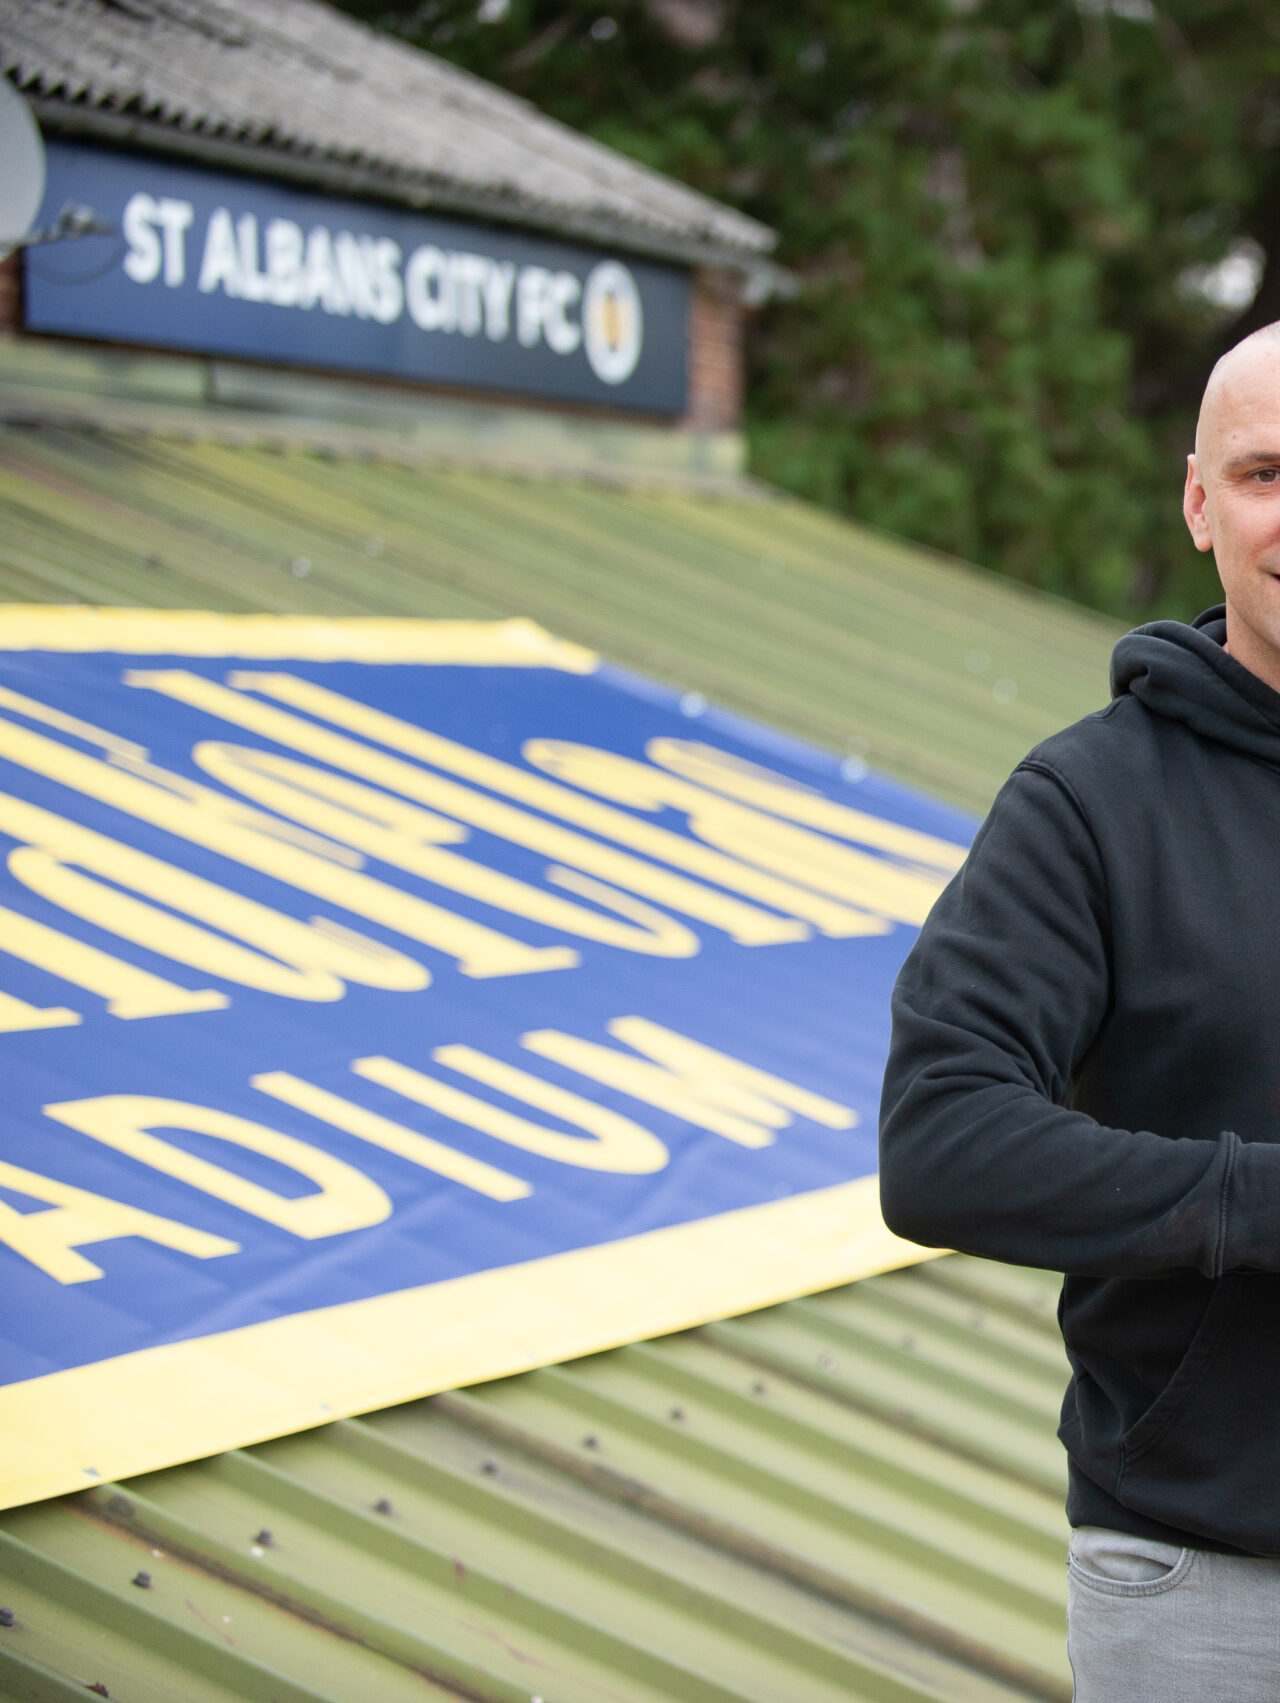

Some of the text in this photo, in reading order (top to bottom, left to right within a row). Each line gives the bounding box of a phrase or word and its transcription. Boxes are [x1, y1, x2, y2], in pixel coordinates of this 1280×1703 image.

[121, 191, 583, 356] ST ALBANS CITY FC
